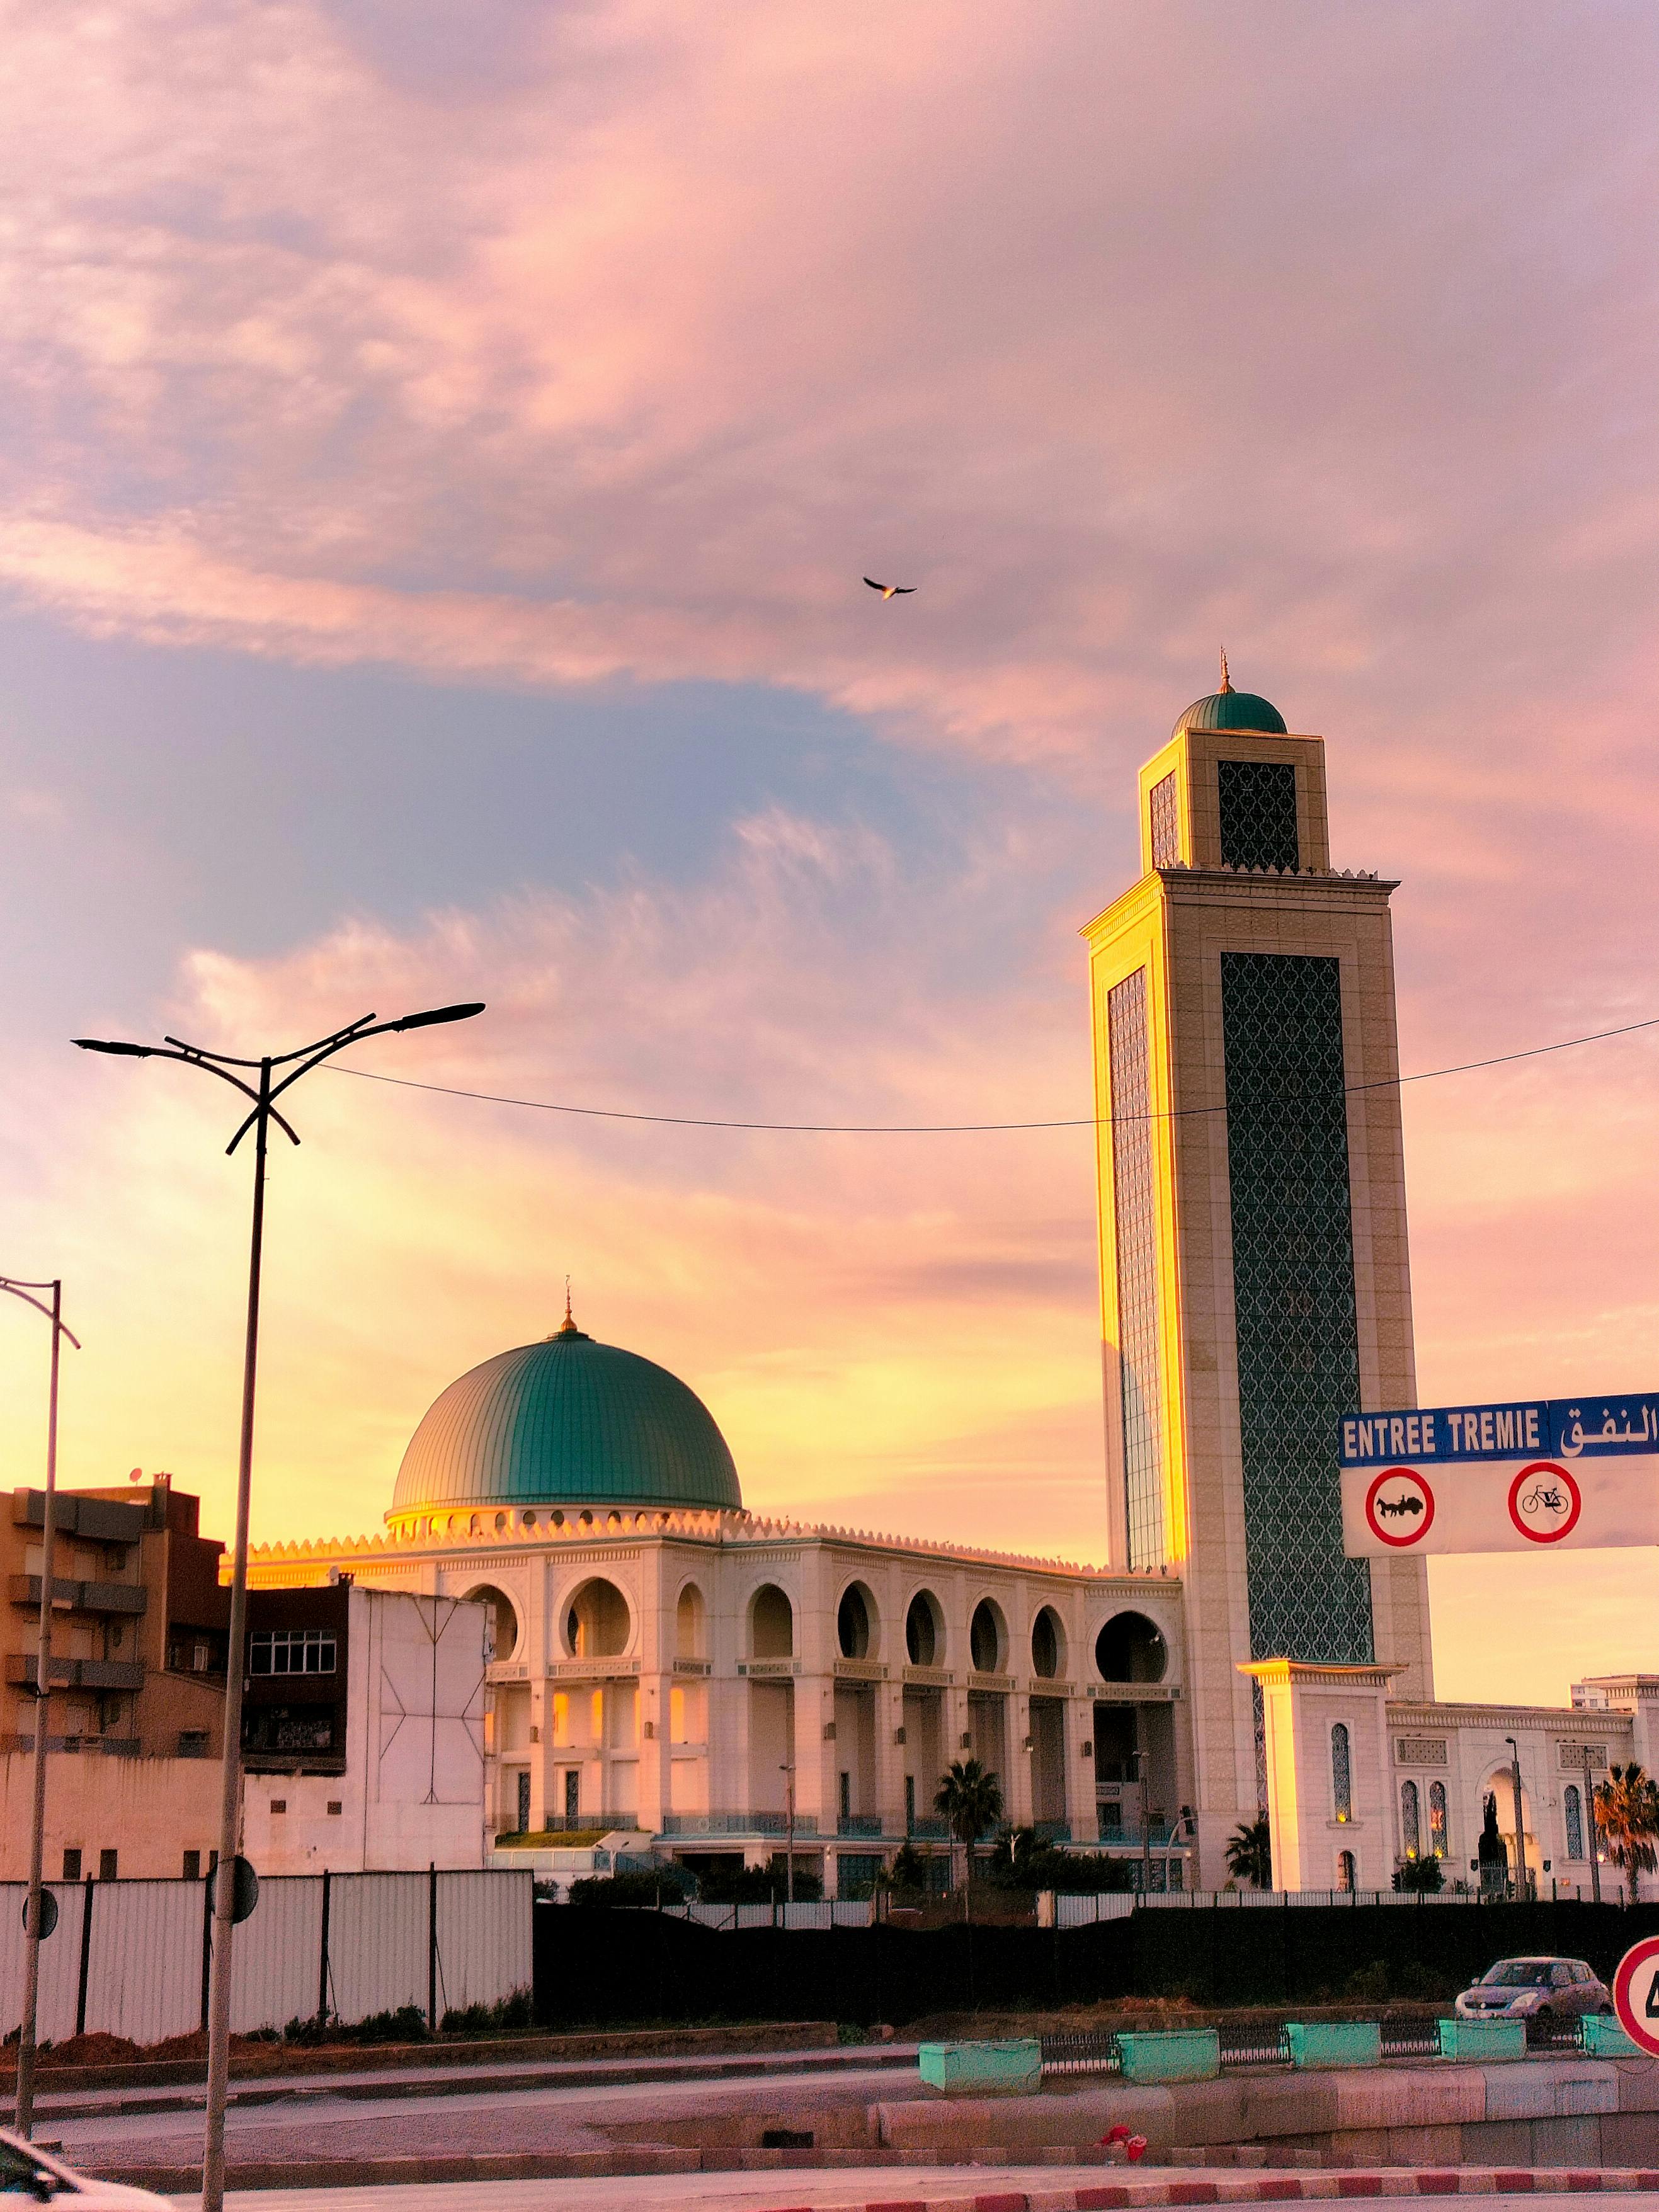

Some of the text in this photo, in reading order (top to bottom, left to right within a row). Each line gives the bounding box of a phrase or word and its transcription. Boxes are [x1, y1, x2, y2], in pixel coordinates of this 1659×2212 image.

[1343, 1409, 1540, 1458] ENTREE TREMIE
[1560, 1404, 1658, 1458] النفق
